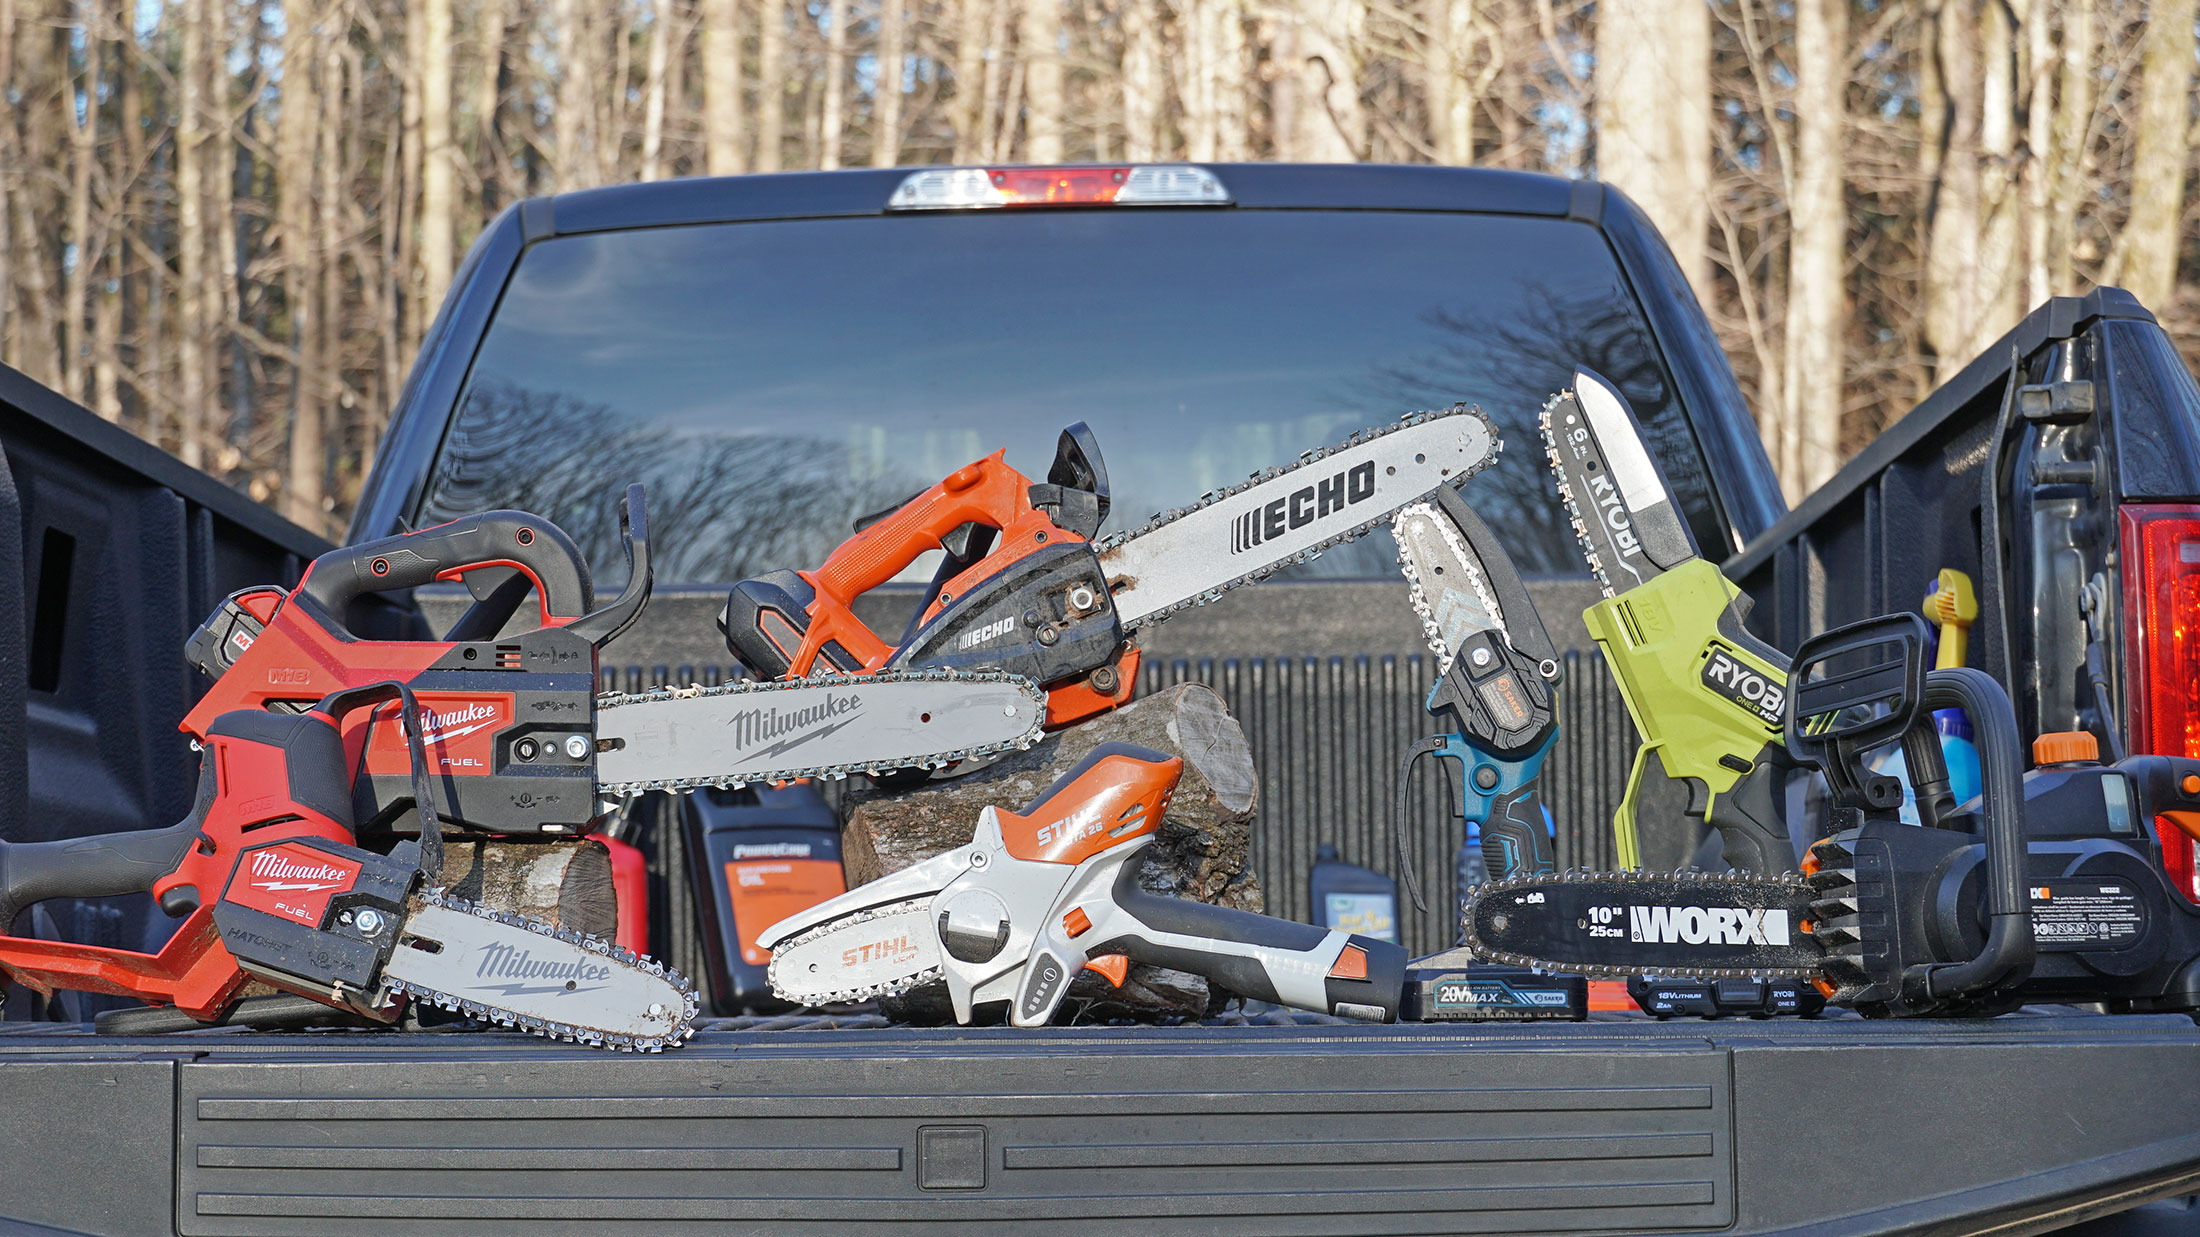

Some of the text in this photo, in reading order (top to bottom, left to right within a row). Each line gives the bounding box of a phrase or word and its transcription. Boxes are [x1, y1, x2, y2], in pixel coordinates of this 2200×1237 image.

[1573, 428, 1588, 442] 6
[1264, 459, 1375, 541] ECHO
[1590, 474, 1641, 557] RYOBI
[971, 616, 1014, 646] ECHO
[271, 669, 309, 684] M18
[1708, 654, 1785, 717] RYOBI
[1504, 691, 1524, 718] SAKER
[1760, 709, 1779, 722] HP
[727, 693, 863, 751] Milwaukee
[441, 758, 484, 766] FUEL
[1088, 822, 1103, 836] 26
[251, 850, 346, 881] Milwaukee
[274, 902, 314, 921] FUEL
[1588, 906, 1623, 924] 10"
[1631, 905, 1790, 946] WORX
[227, 927, 292, 954] HATCHET
[842, 935, 918, 968] STIHL
[477, 940, 611, 981] Milwaukee
[1772, 990, 1795, 998] RYOBI
